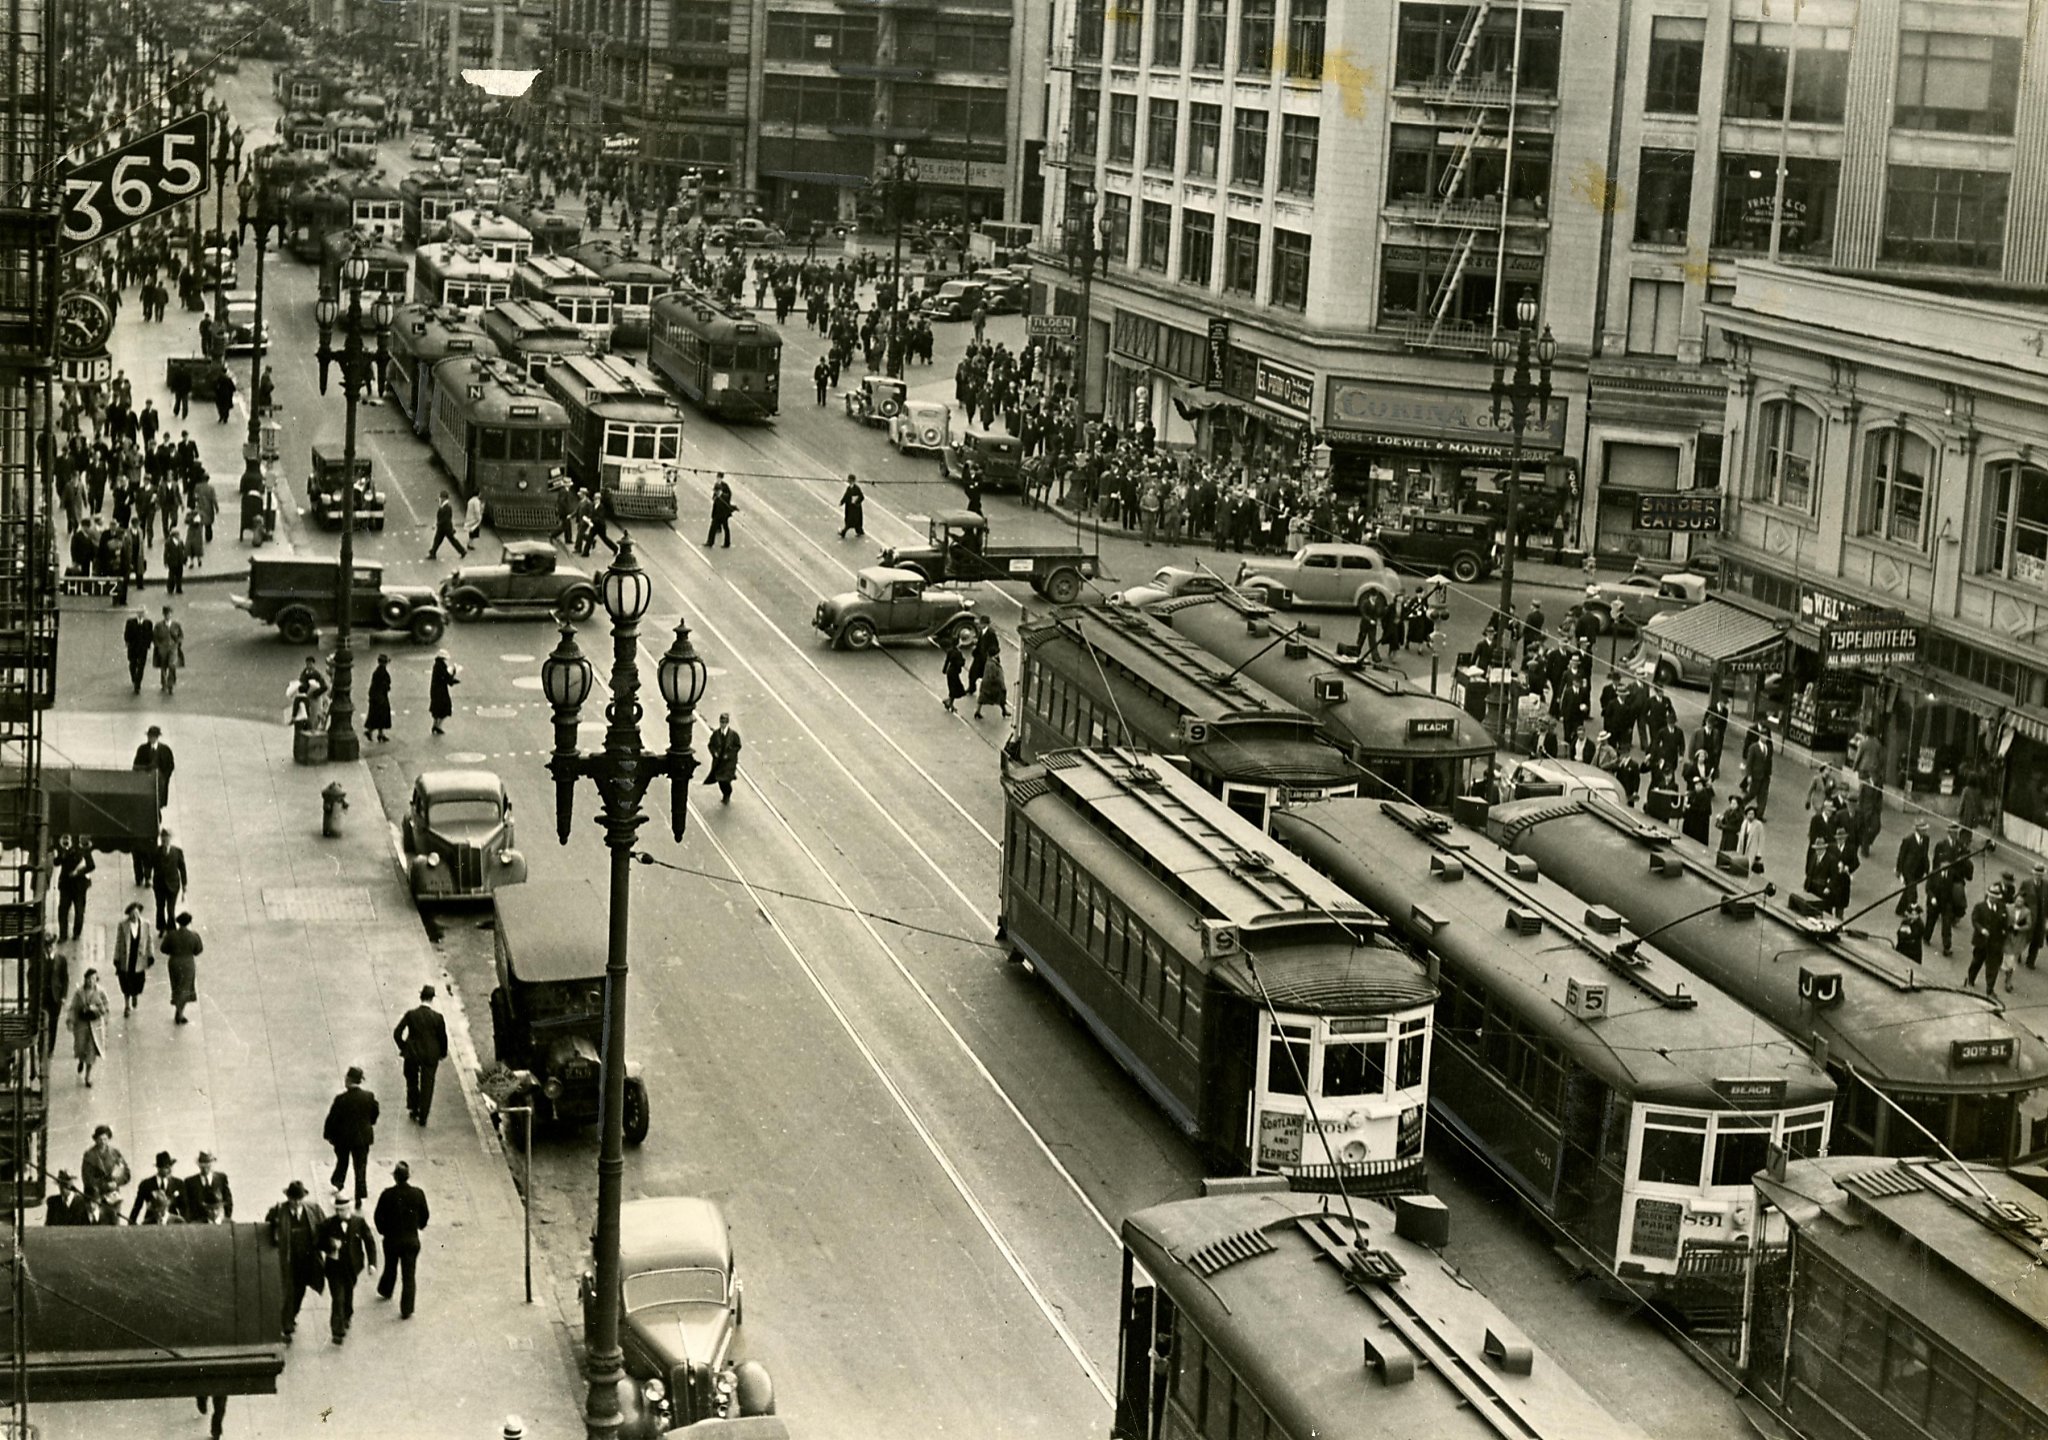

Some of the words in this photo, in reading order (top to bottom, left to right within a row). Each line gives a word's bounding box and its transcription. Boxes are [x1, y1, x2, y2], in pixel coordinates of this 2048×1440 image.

[937, 164, 988, 178] FURNIURE
[64, 133, 201, 240] 365
[1034, 317, 1071, 327] TILDEN
[52, 358, 111, 383] LUB
[470, 386, 482, 399] N
[1377, 435, 1431, 449] LOEWEL
[1436, 441, 1444, 450] &
[1449, 442, 1501, 456] MARTIN
[1641, 498, 1716, 513] SNIDER
[1640, 514, 1716, 529] CATSUP
[1830, 628, 1917, 651] TYPEWRITERS
[1730, 662, 1782, 672] TOBACCO
[1325, 684, 1340, 700] L
[1191, 724, 1207, 741] 9
[1417, 723, 1449, 732] BEACH
[1817, 978, 1838, 1000] J
[1585, 989, 1604, 1011] 5
[1730, 1085, 1771, 1095] BEACH
[1262, 1115, 1301, 1130] CORTLAND
[1283, 1128, 1299, 1138] AVE
[1273, 1137, 1290, 1145] AND
[1261, 1145, 1300, 1163] FERRIES
[1641, 1219, 1673, 1232] PARK
[1683, 1214, 1722, 1228] 831
